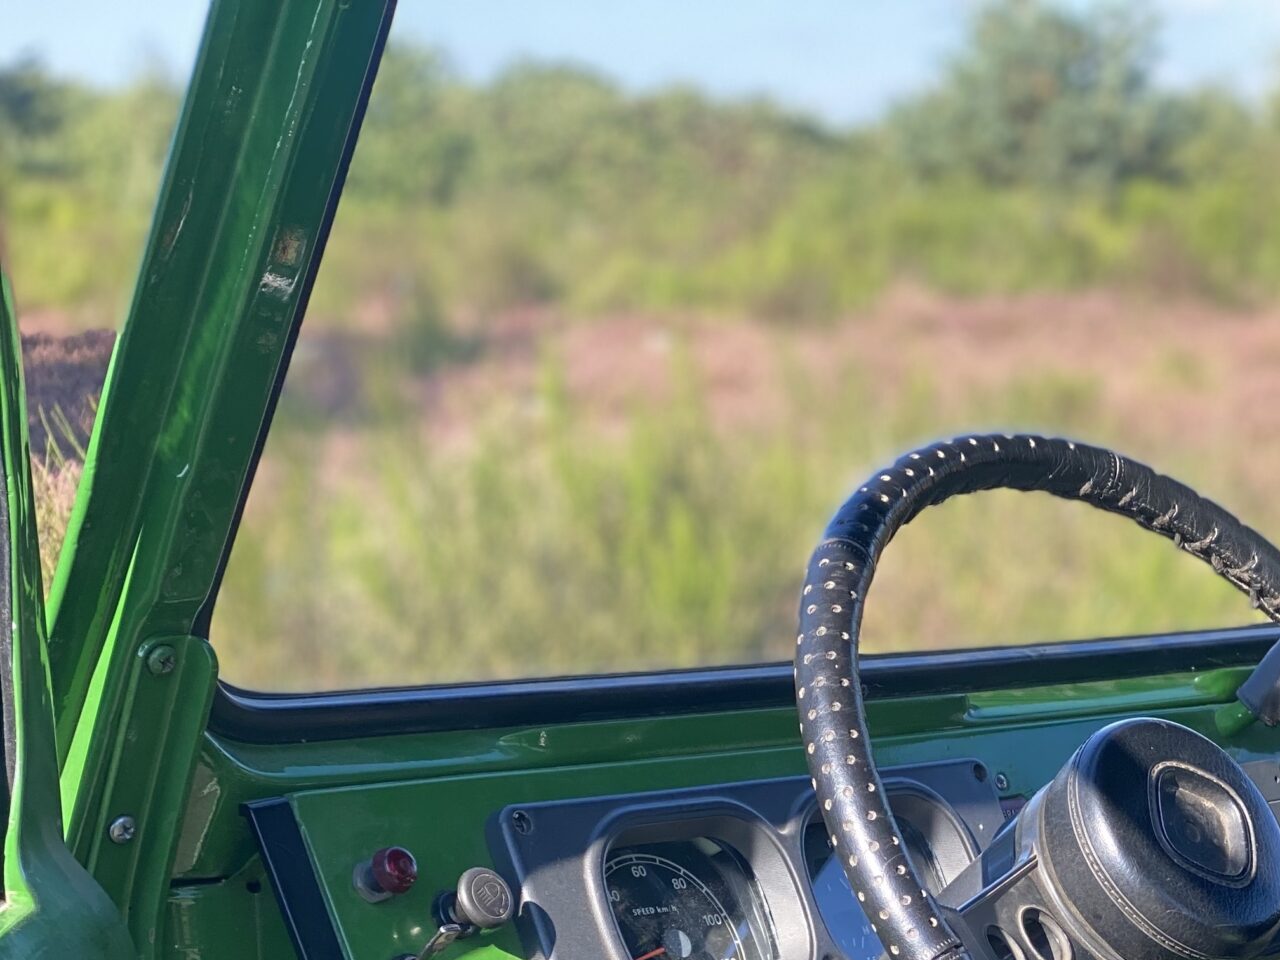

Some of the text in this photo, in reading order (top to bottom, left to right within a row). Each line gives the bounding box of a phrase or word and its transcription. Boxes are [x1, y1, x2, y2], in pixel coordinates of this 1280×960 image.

[631, 865, 647, 878] 60
[672, 877, 687, 890] 80
[632, 907, 655, 916] SPEED
[702, 914, 722, 926] 100
